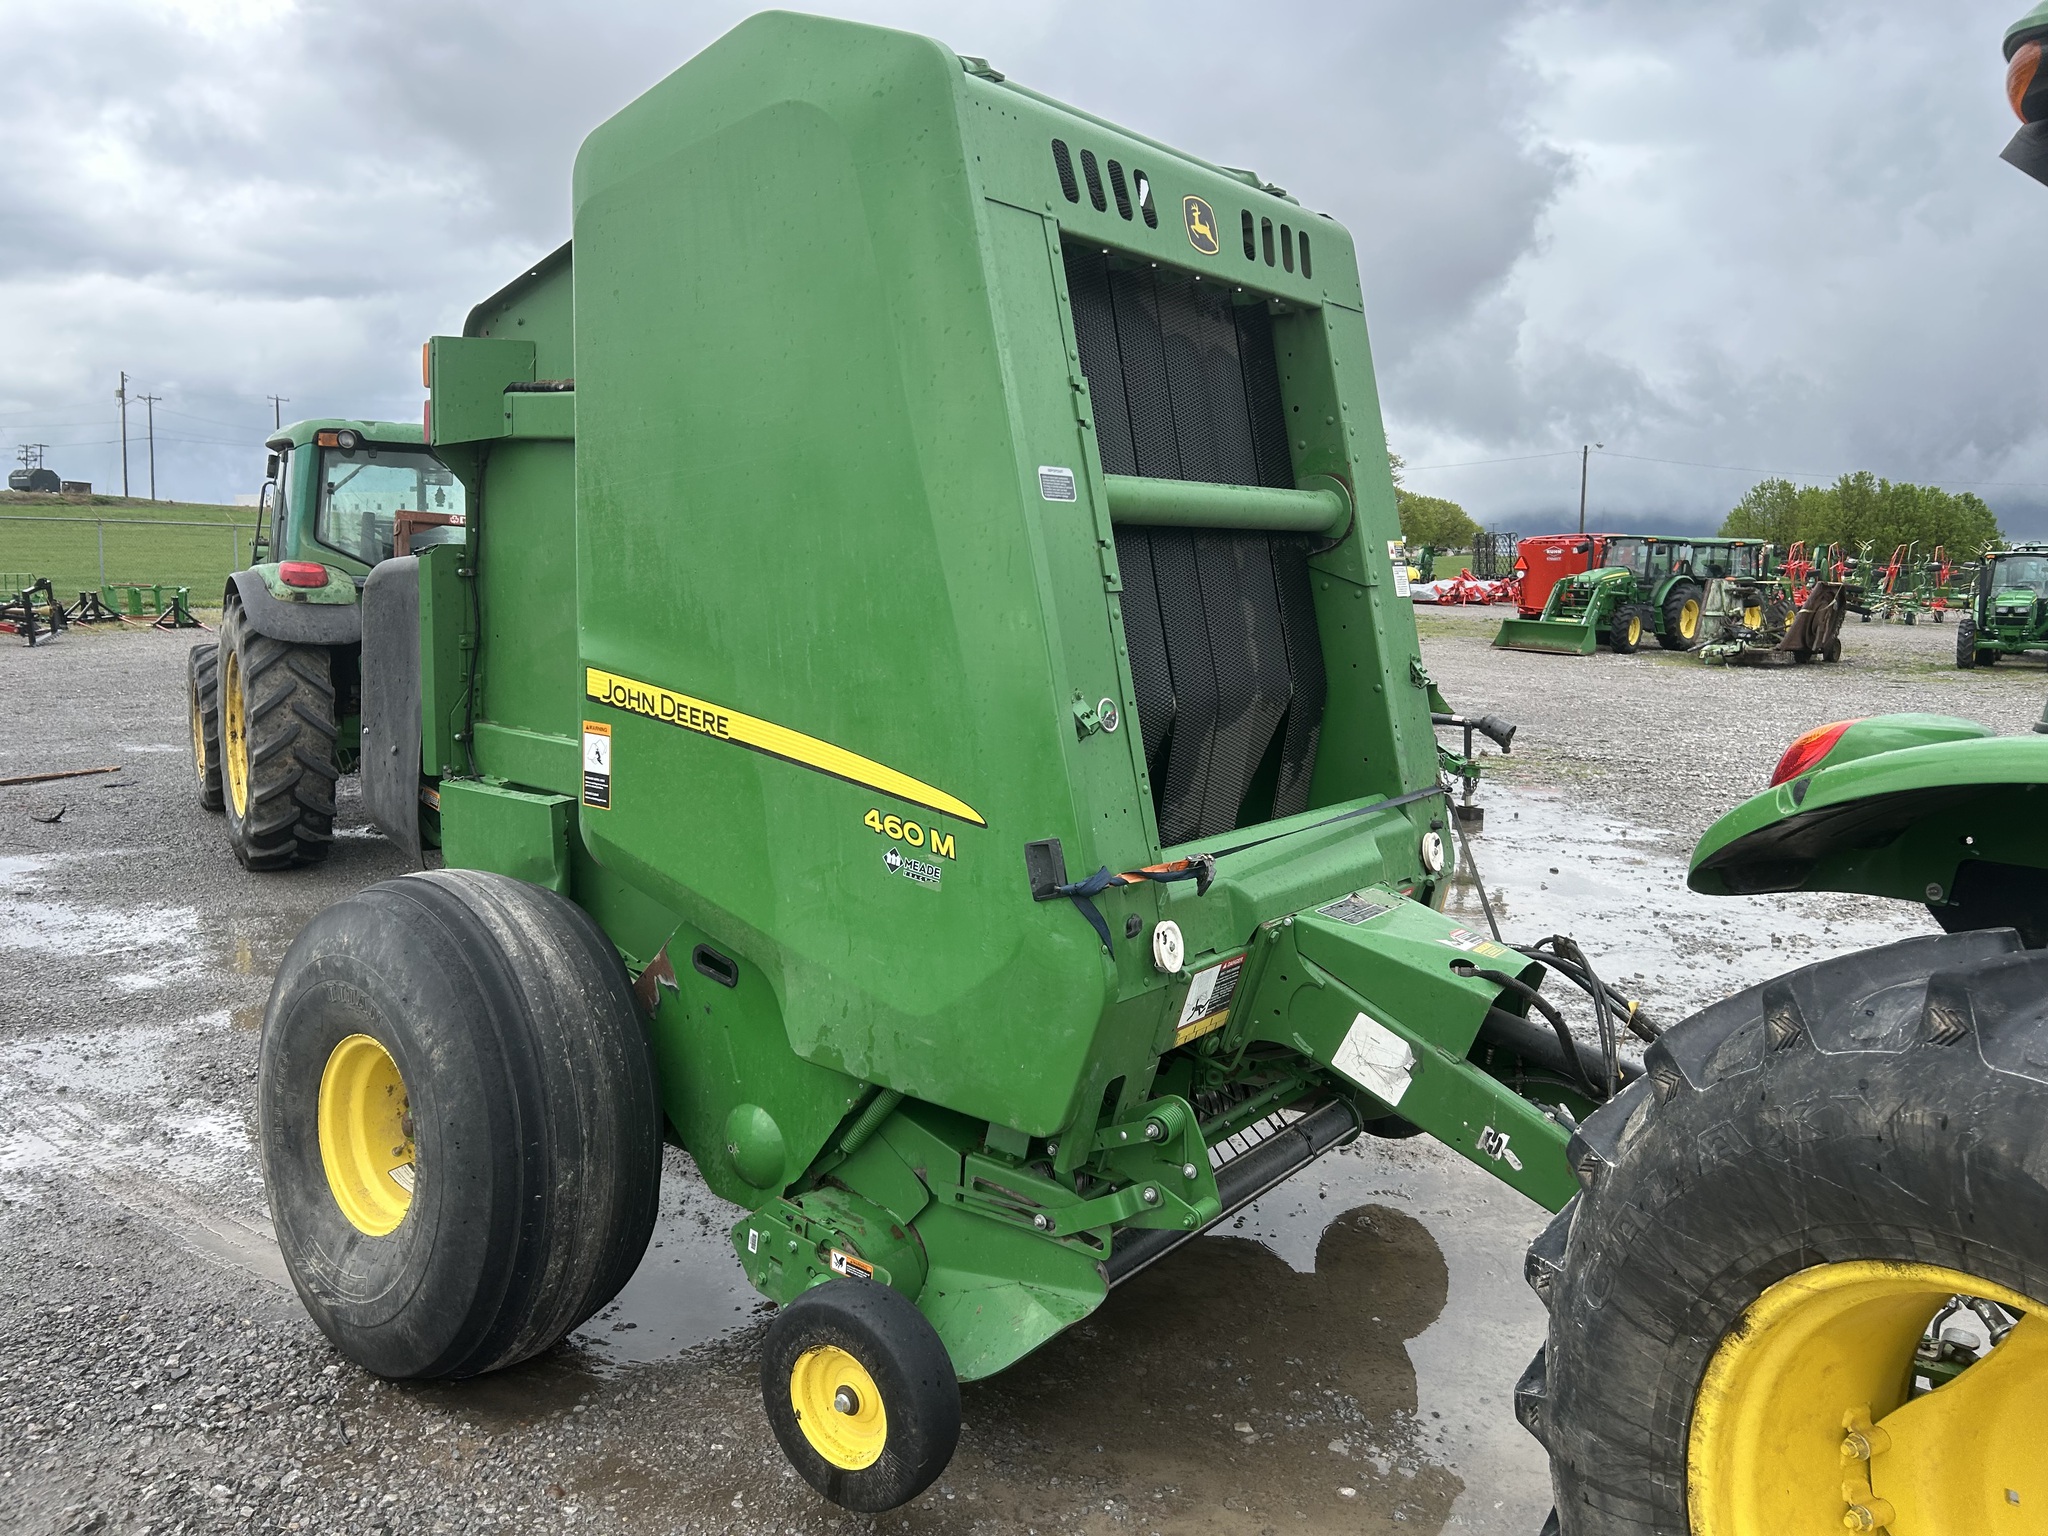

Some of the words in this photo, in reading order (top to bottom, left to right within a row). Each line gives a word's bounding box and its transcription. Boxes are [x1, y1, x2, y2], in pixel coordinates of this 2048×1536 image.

[602, 679, 655, 713] JOHN
[661, 694, 729, 736] DEERE
[864, 808, 925, 847] 460
[929, 827, 957, 861] M
[904, 857, 941, 879] MEADE
